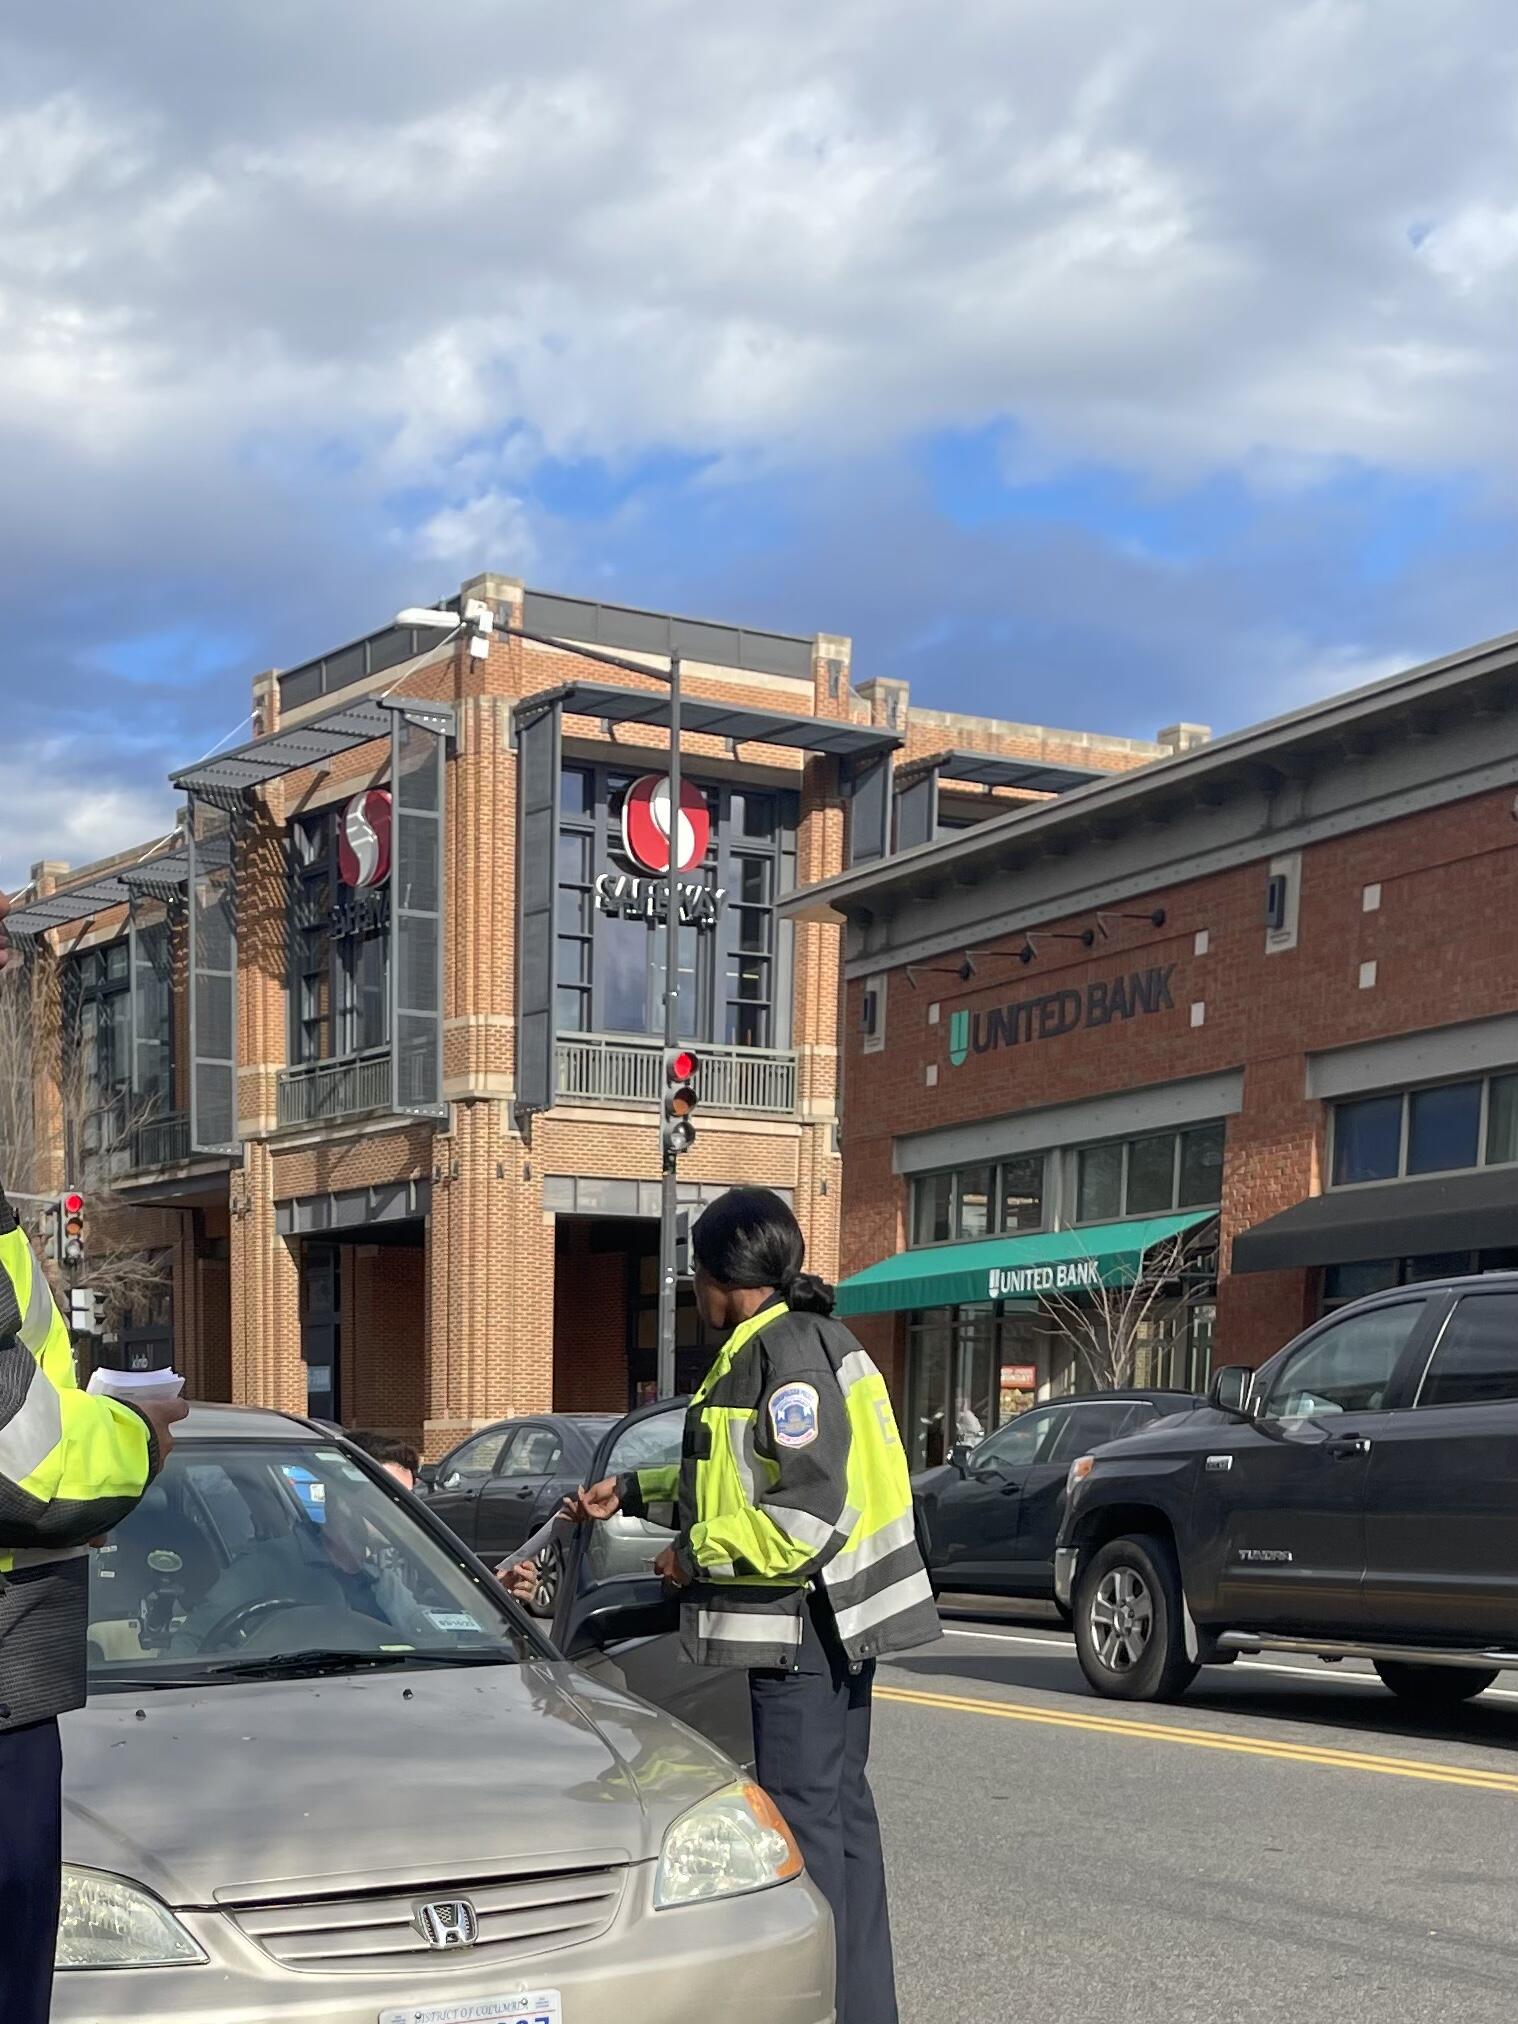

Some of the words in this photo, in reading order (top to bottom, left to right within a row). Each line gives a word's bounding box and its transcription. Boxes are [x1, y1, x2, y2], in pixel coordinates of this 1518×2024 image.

[972, 989, 1081, 1053] UNITED
[1085, 964, 1177, 1028] BANK
[1001, 1267, 1053, 1293] UNITED
[1056, 1261, 1099, 1287] BANK
[460, 2006, 474, 2019] OF
